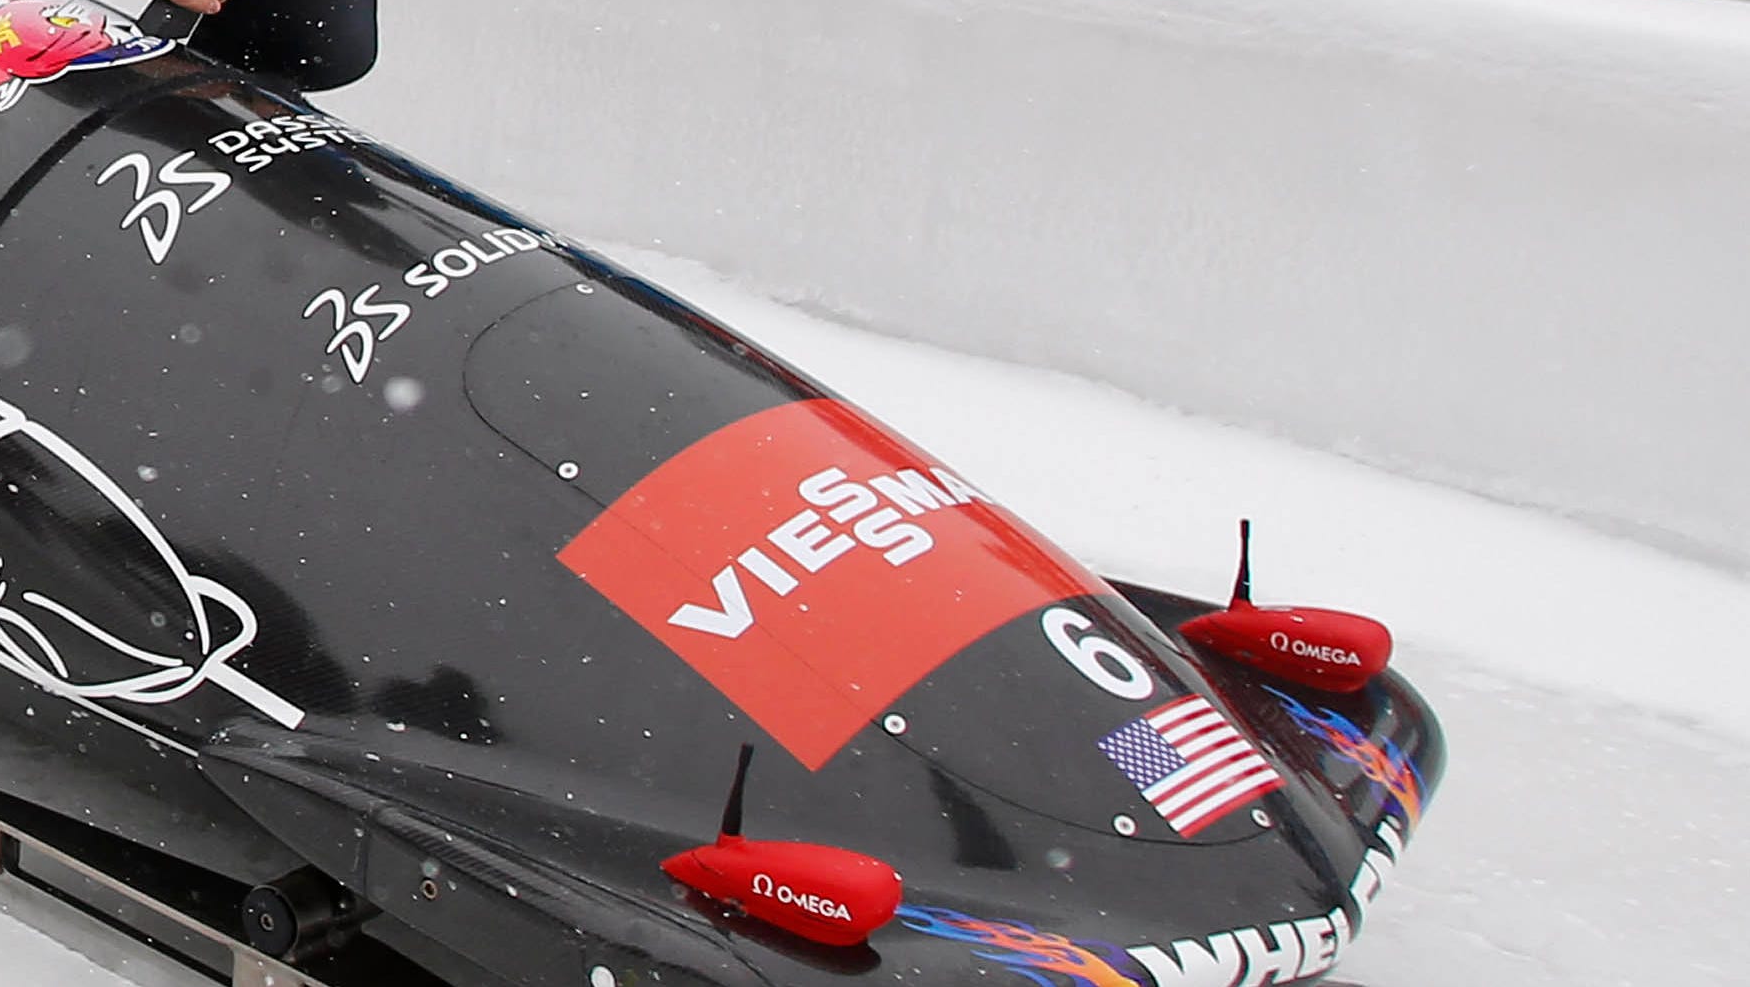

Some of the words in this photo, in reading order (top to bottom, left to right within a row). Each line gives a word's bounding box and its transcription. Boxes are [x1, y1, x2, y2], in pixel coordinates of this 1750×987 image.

[666, 466, 996, 640] VIESSMA
[1041, 606, 1154, 701] 6
[1292, 639, 1362, 667] OMEGA
[776, 885, 853, 922] OMEGA
